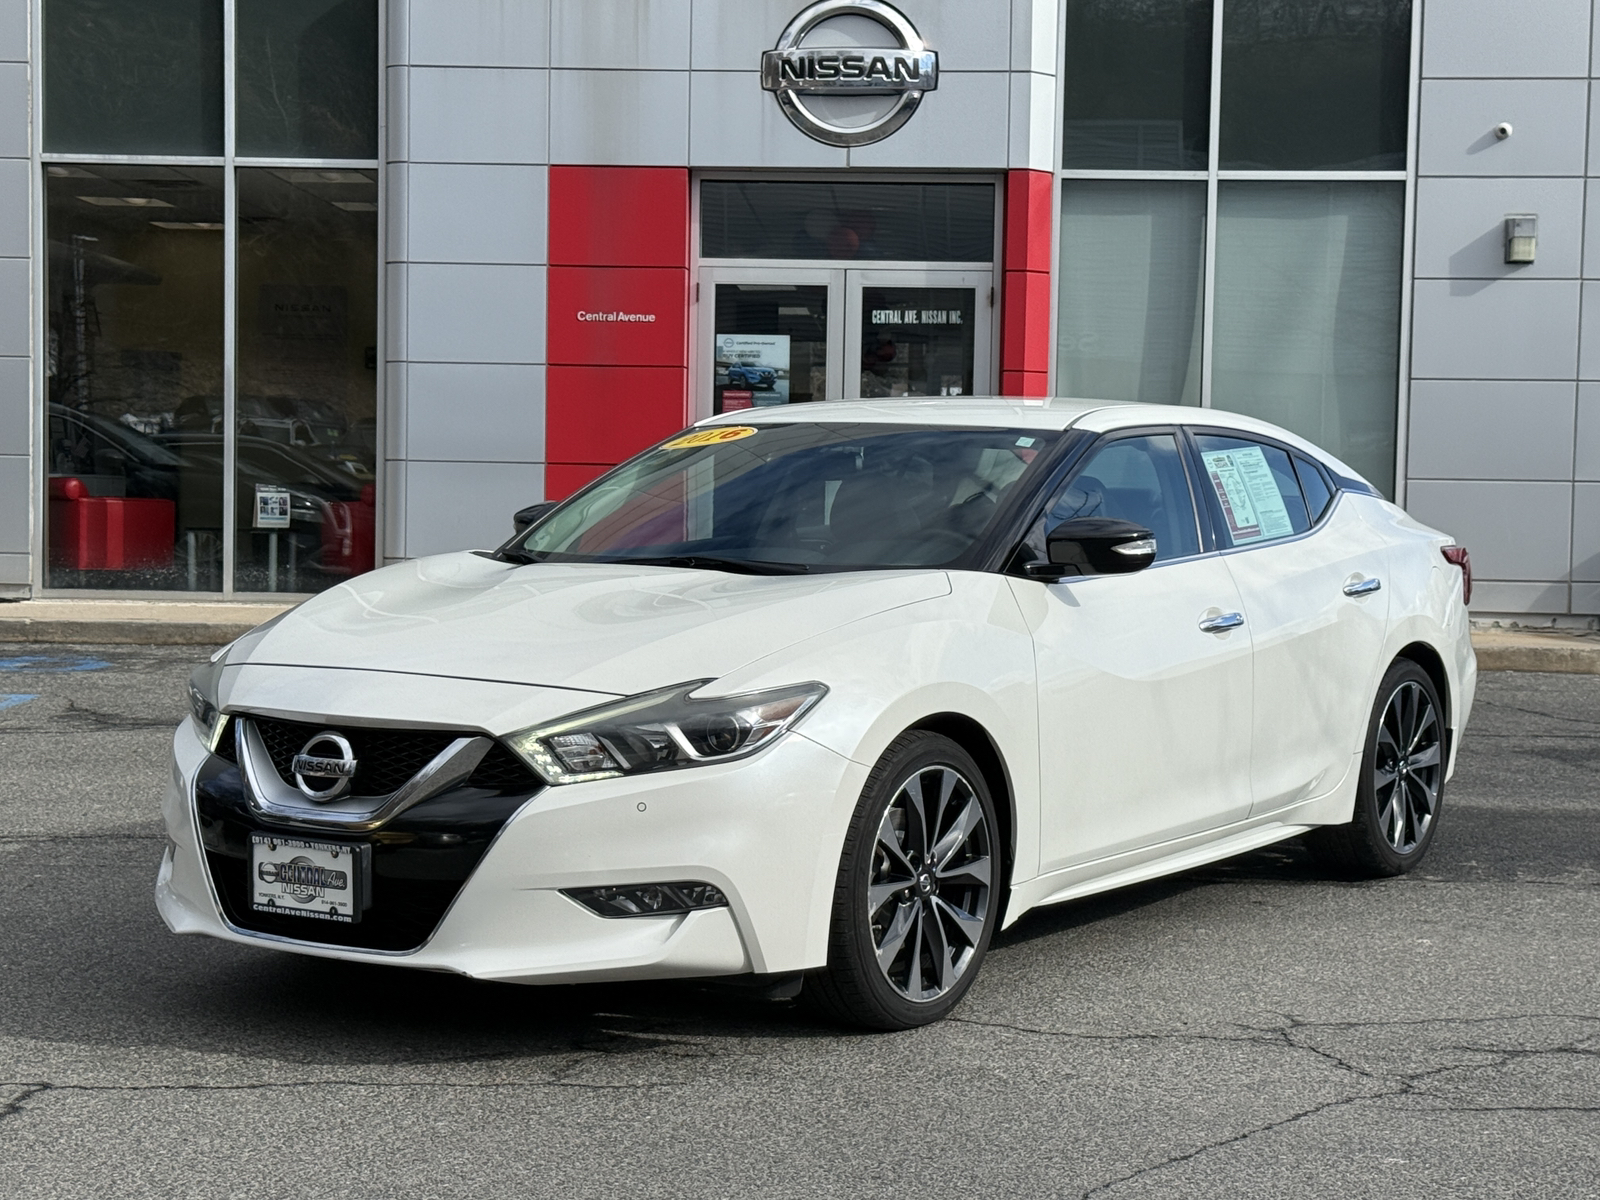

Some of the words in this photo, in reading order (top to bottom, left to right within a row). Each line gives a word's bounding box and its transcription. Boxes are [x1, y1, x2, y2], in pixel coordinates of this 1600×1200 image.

[780, 55, 920, 82] NISSAN
[274, 303, 332, 312] NISSAN
[577, 310, 616, 321] Central
[617, 311, 656, 322] Avenue
[871, 309, 902, 324] CENTRAL
[903, 309, 920, 324] AVE.
[921, 310, 947, 324] NISSAN
[948, 310, 964, 325] INC.
[669, 428, 748, 447] 2016
[294, 759, 346, 774] NISSAN
[280, 862, 326, 886] CENTRAL
[326, 871, 346, 888] Ave.
[281, 882, 326, 899] NISSAN
